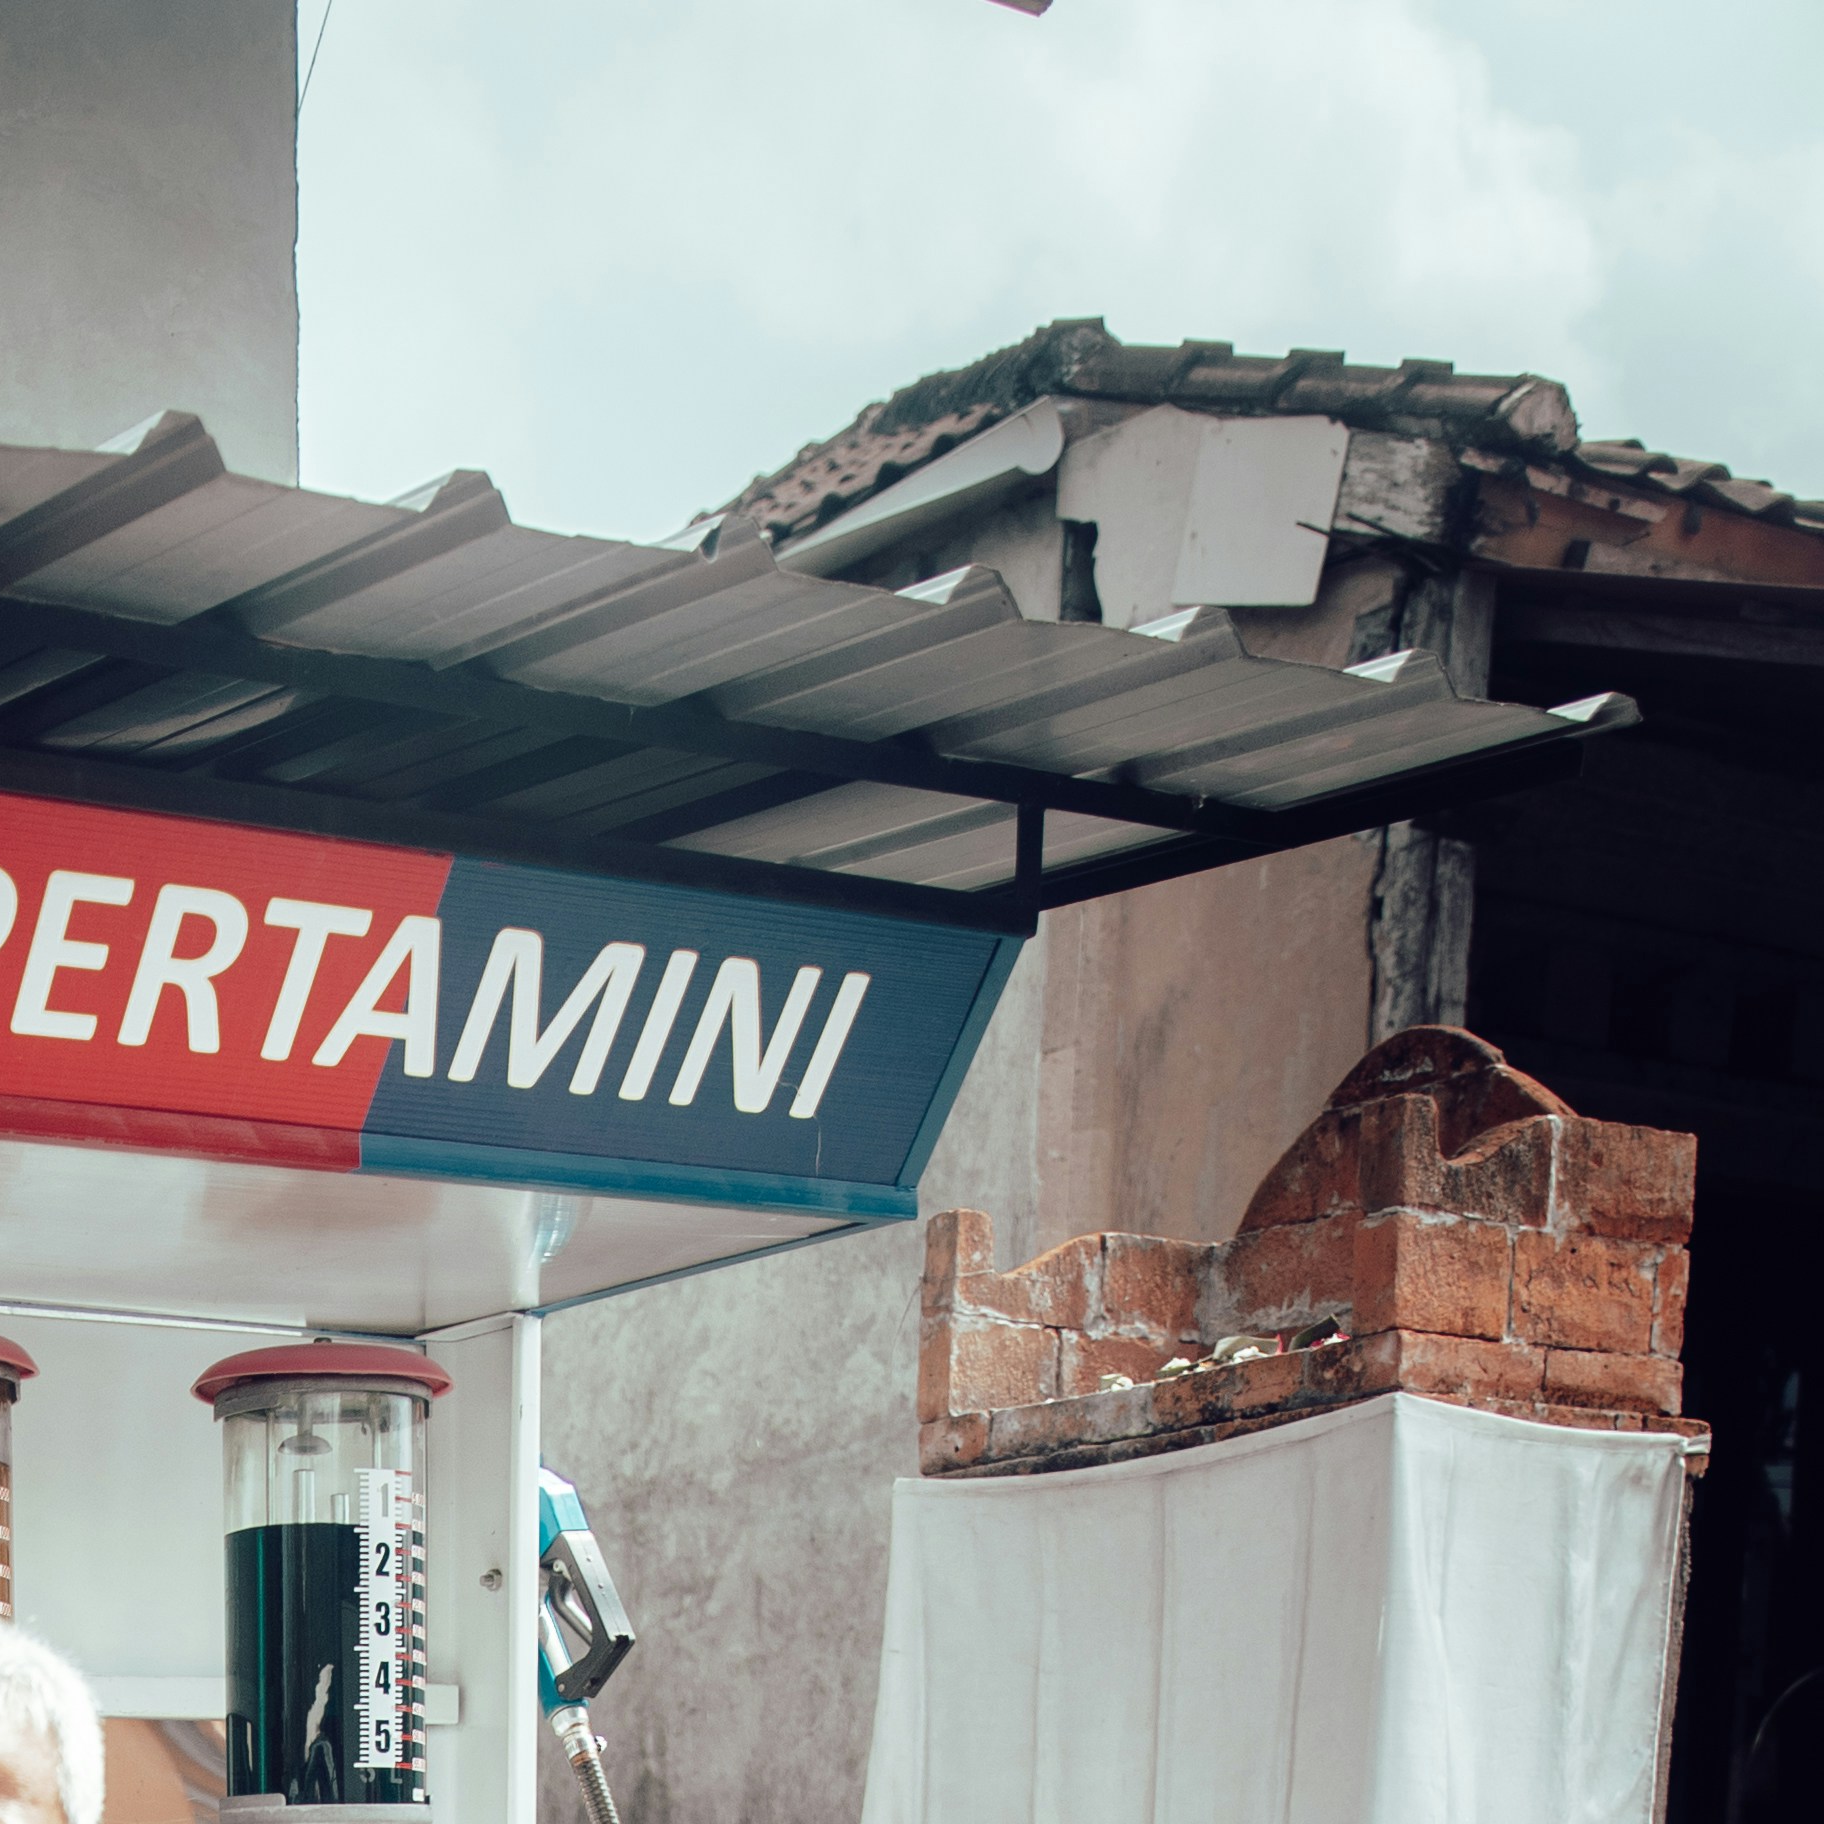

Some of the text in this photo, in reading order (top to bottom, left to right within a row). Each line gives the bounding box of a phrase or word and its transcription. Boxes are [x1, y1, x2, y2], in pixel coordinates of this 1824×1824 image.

[377, 1482, 389, 1518] 1
[375, 1542, 390, 1577] 2
[374, 1601, 391, 1636] 3
[374, 1661, 391, 1695] 4
[374, 1719, 391, 1754] 5
